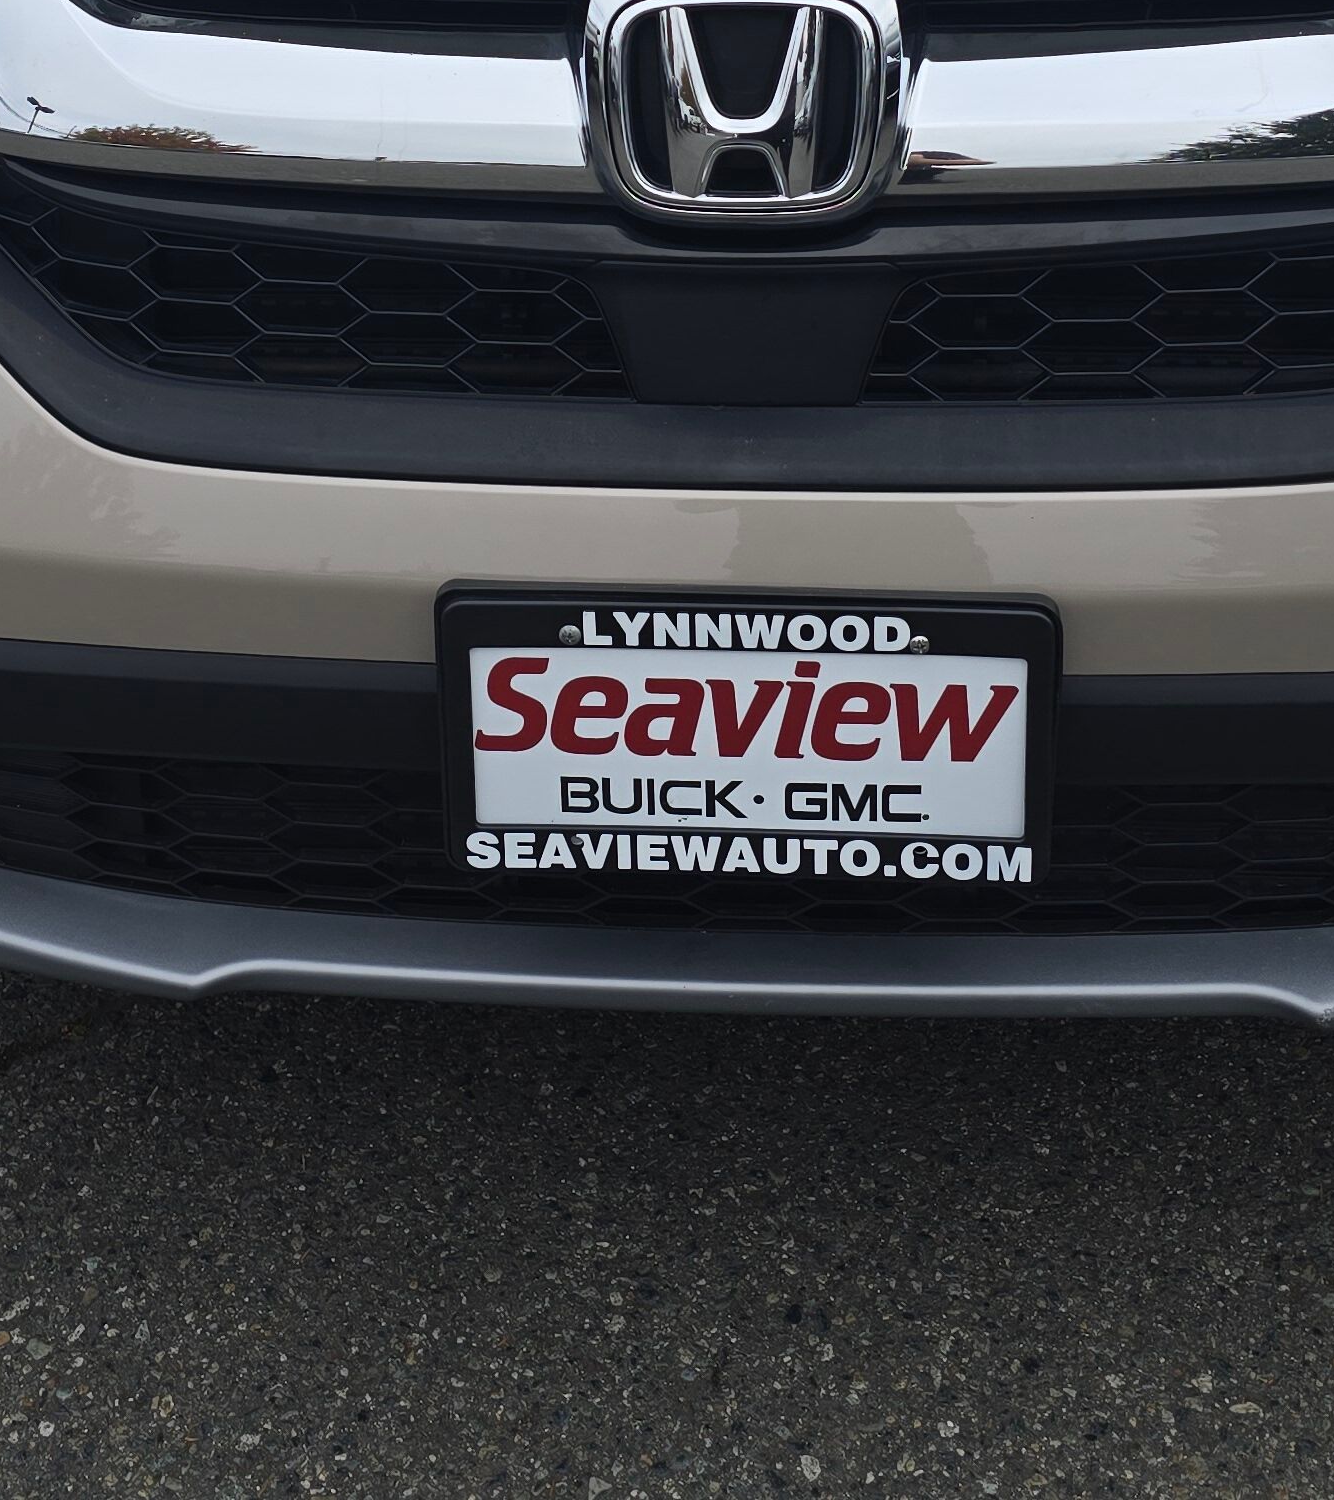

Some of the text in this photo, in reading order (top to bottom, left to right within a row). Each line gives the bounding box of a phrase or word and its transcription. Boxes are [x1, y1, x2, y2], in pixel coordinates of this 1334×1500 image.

[581, 610, 912, 652] LYNNWOOD
[473, 655, 1020, 763] Seaview
[559, 775, 925, 823] BUICK GMC
[465, 831, 1033, 883] SEAVIEWAUTO.COM
